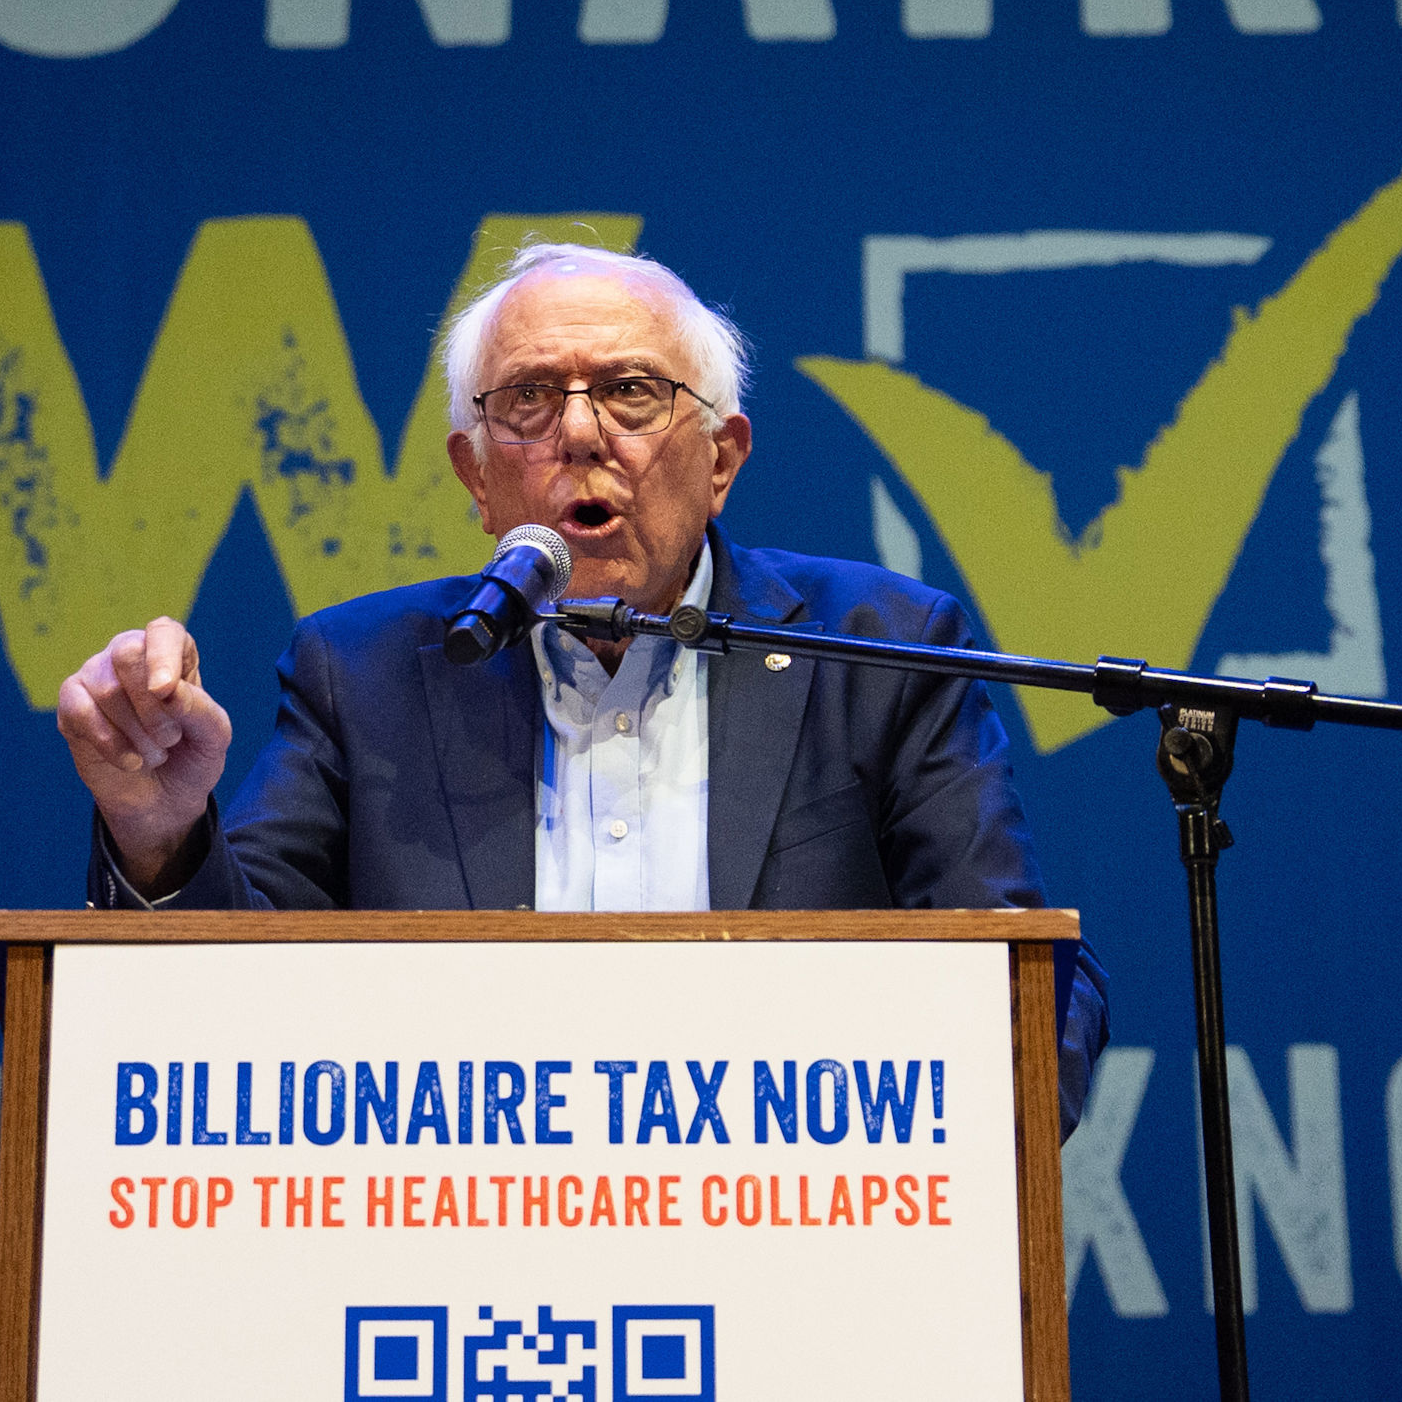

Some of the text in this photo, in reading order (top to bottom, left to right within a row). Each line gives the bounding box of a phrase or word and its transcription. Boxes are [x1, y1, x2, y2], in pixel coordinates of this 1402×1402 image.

[114, 1058, 947, 1146] BILLIONAIRE TAX NOW!
[108, 1173, 953, 1230] STOP THE HEALTHCARE COLLAPSE
